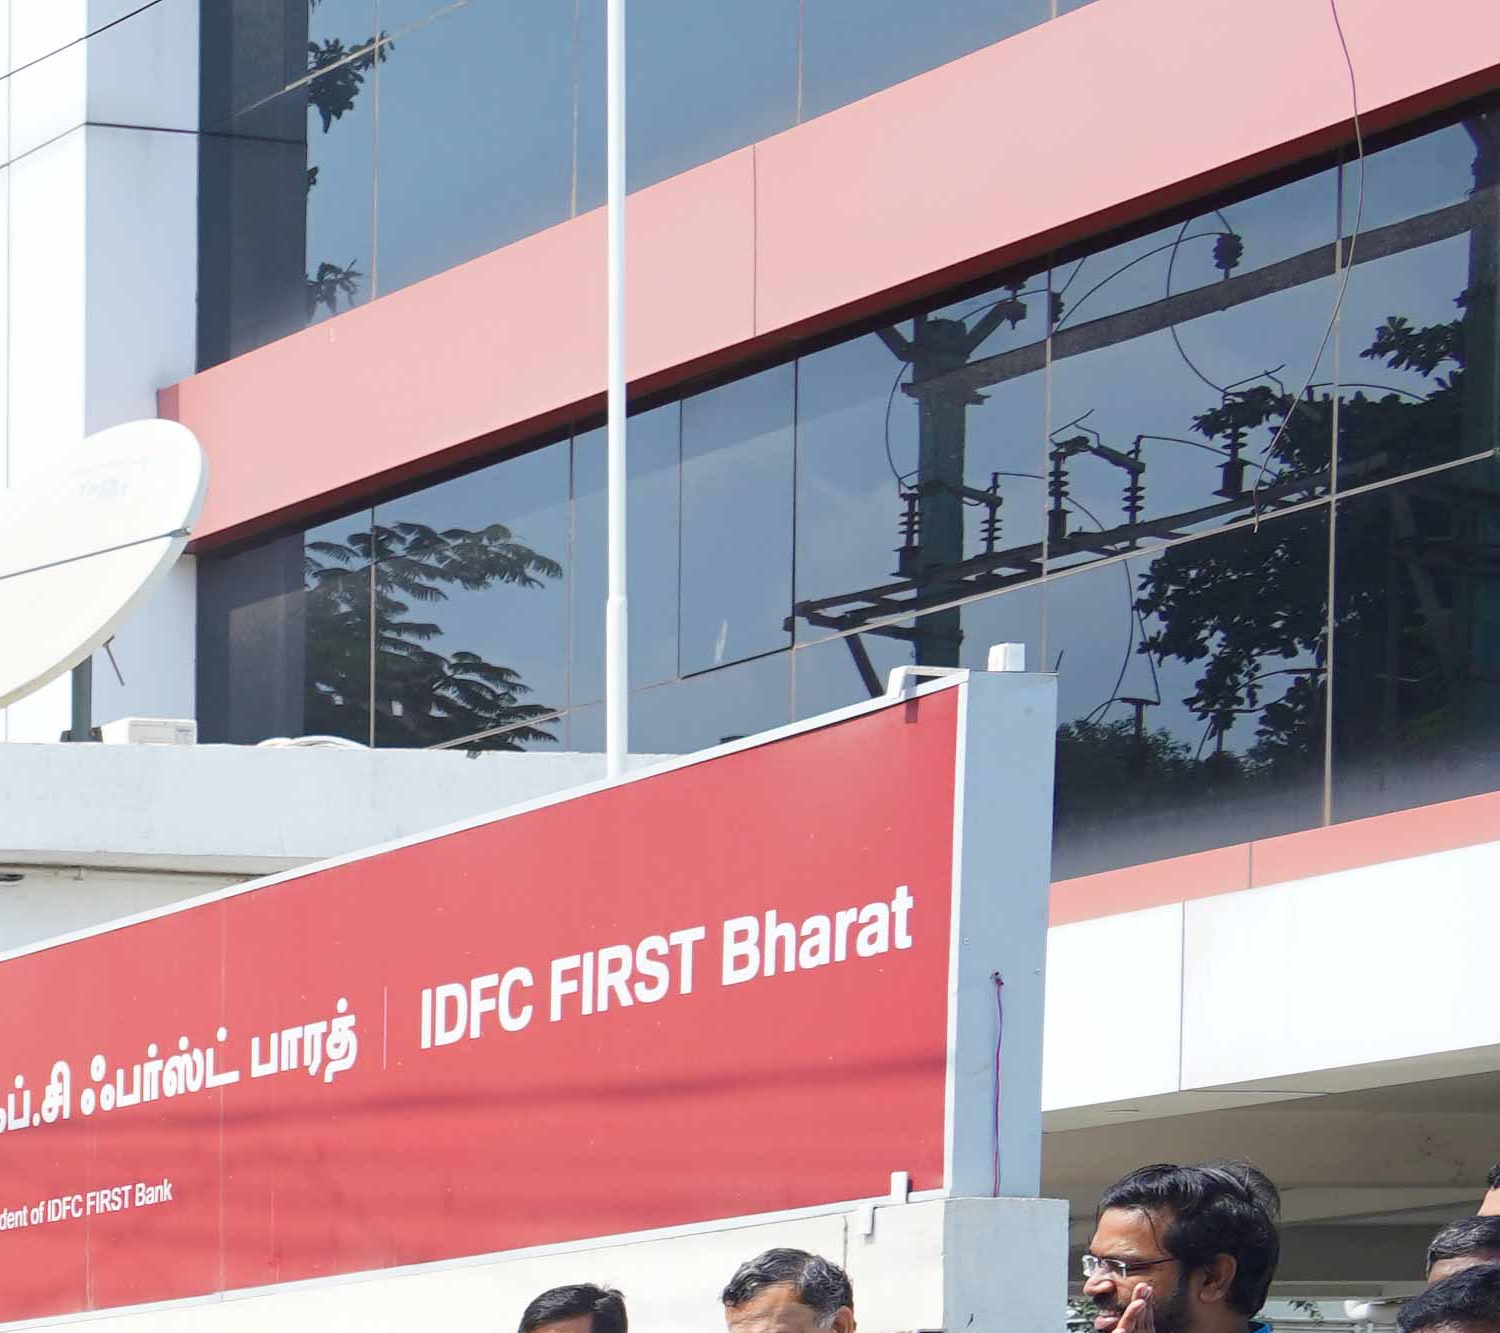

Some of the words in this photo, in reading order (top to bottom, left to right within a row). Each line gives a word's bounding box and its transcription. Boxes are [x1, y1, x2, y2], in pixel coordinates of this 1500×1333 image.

[420, 966, 534, 1050] IDFC
[549, 926, 706, 1023] FIRST
[721, 885, 914, 986] Bharat
[251, 998, 358, 1083] பாரத்
[30, 1200, 44, 1226] of
[47, 1194, 83, 1223] IDFC
[86, 1186, 131, 1215] FIRST
[134, 1179, 173, 1209] Bank
